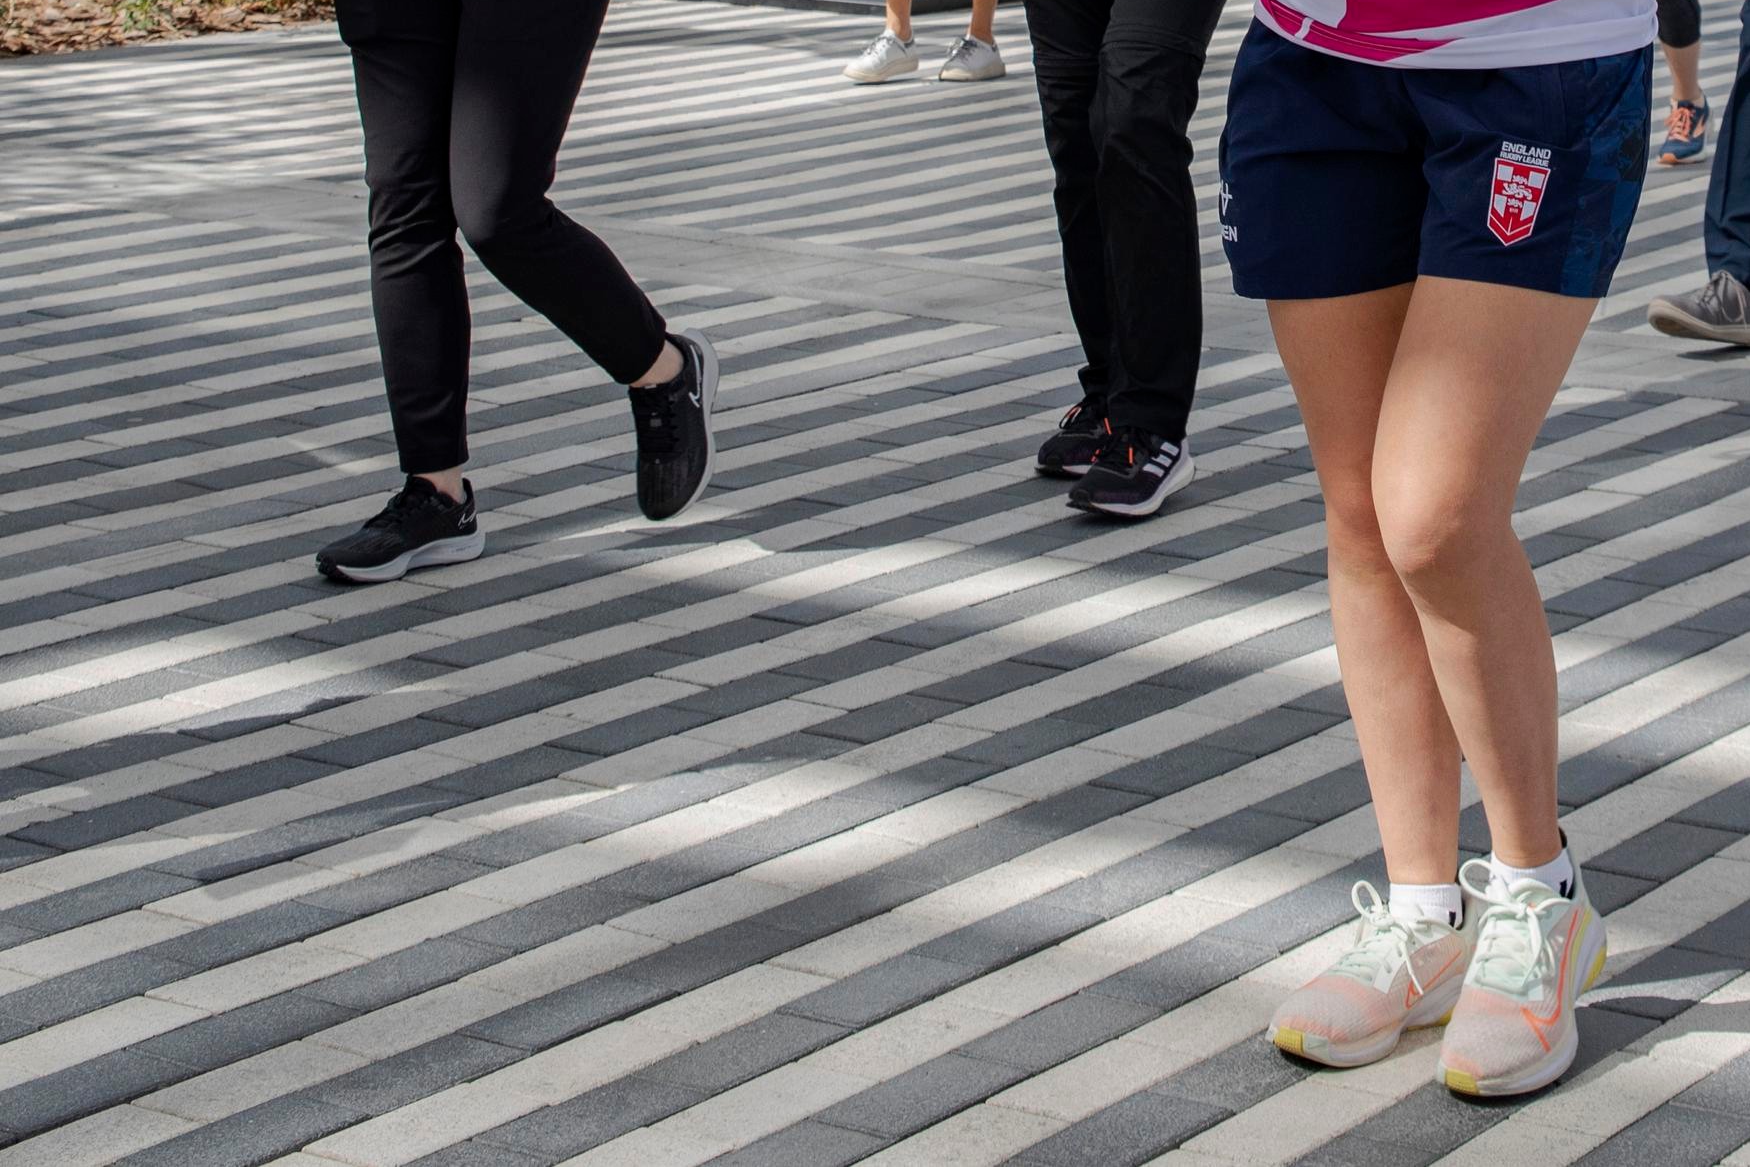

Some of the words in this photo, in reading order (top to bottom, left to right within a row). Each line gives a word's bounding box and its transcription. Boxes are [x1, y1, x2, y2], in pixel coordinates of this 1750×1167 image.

[1500, 151, 1523, 162] RUGBY
[1523, 156, 1550, 167] LEAGUE
[1502, 141, 1552, 160] ENGLAND
